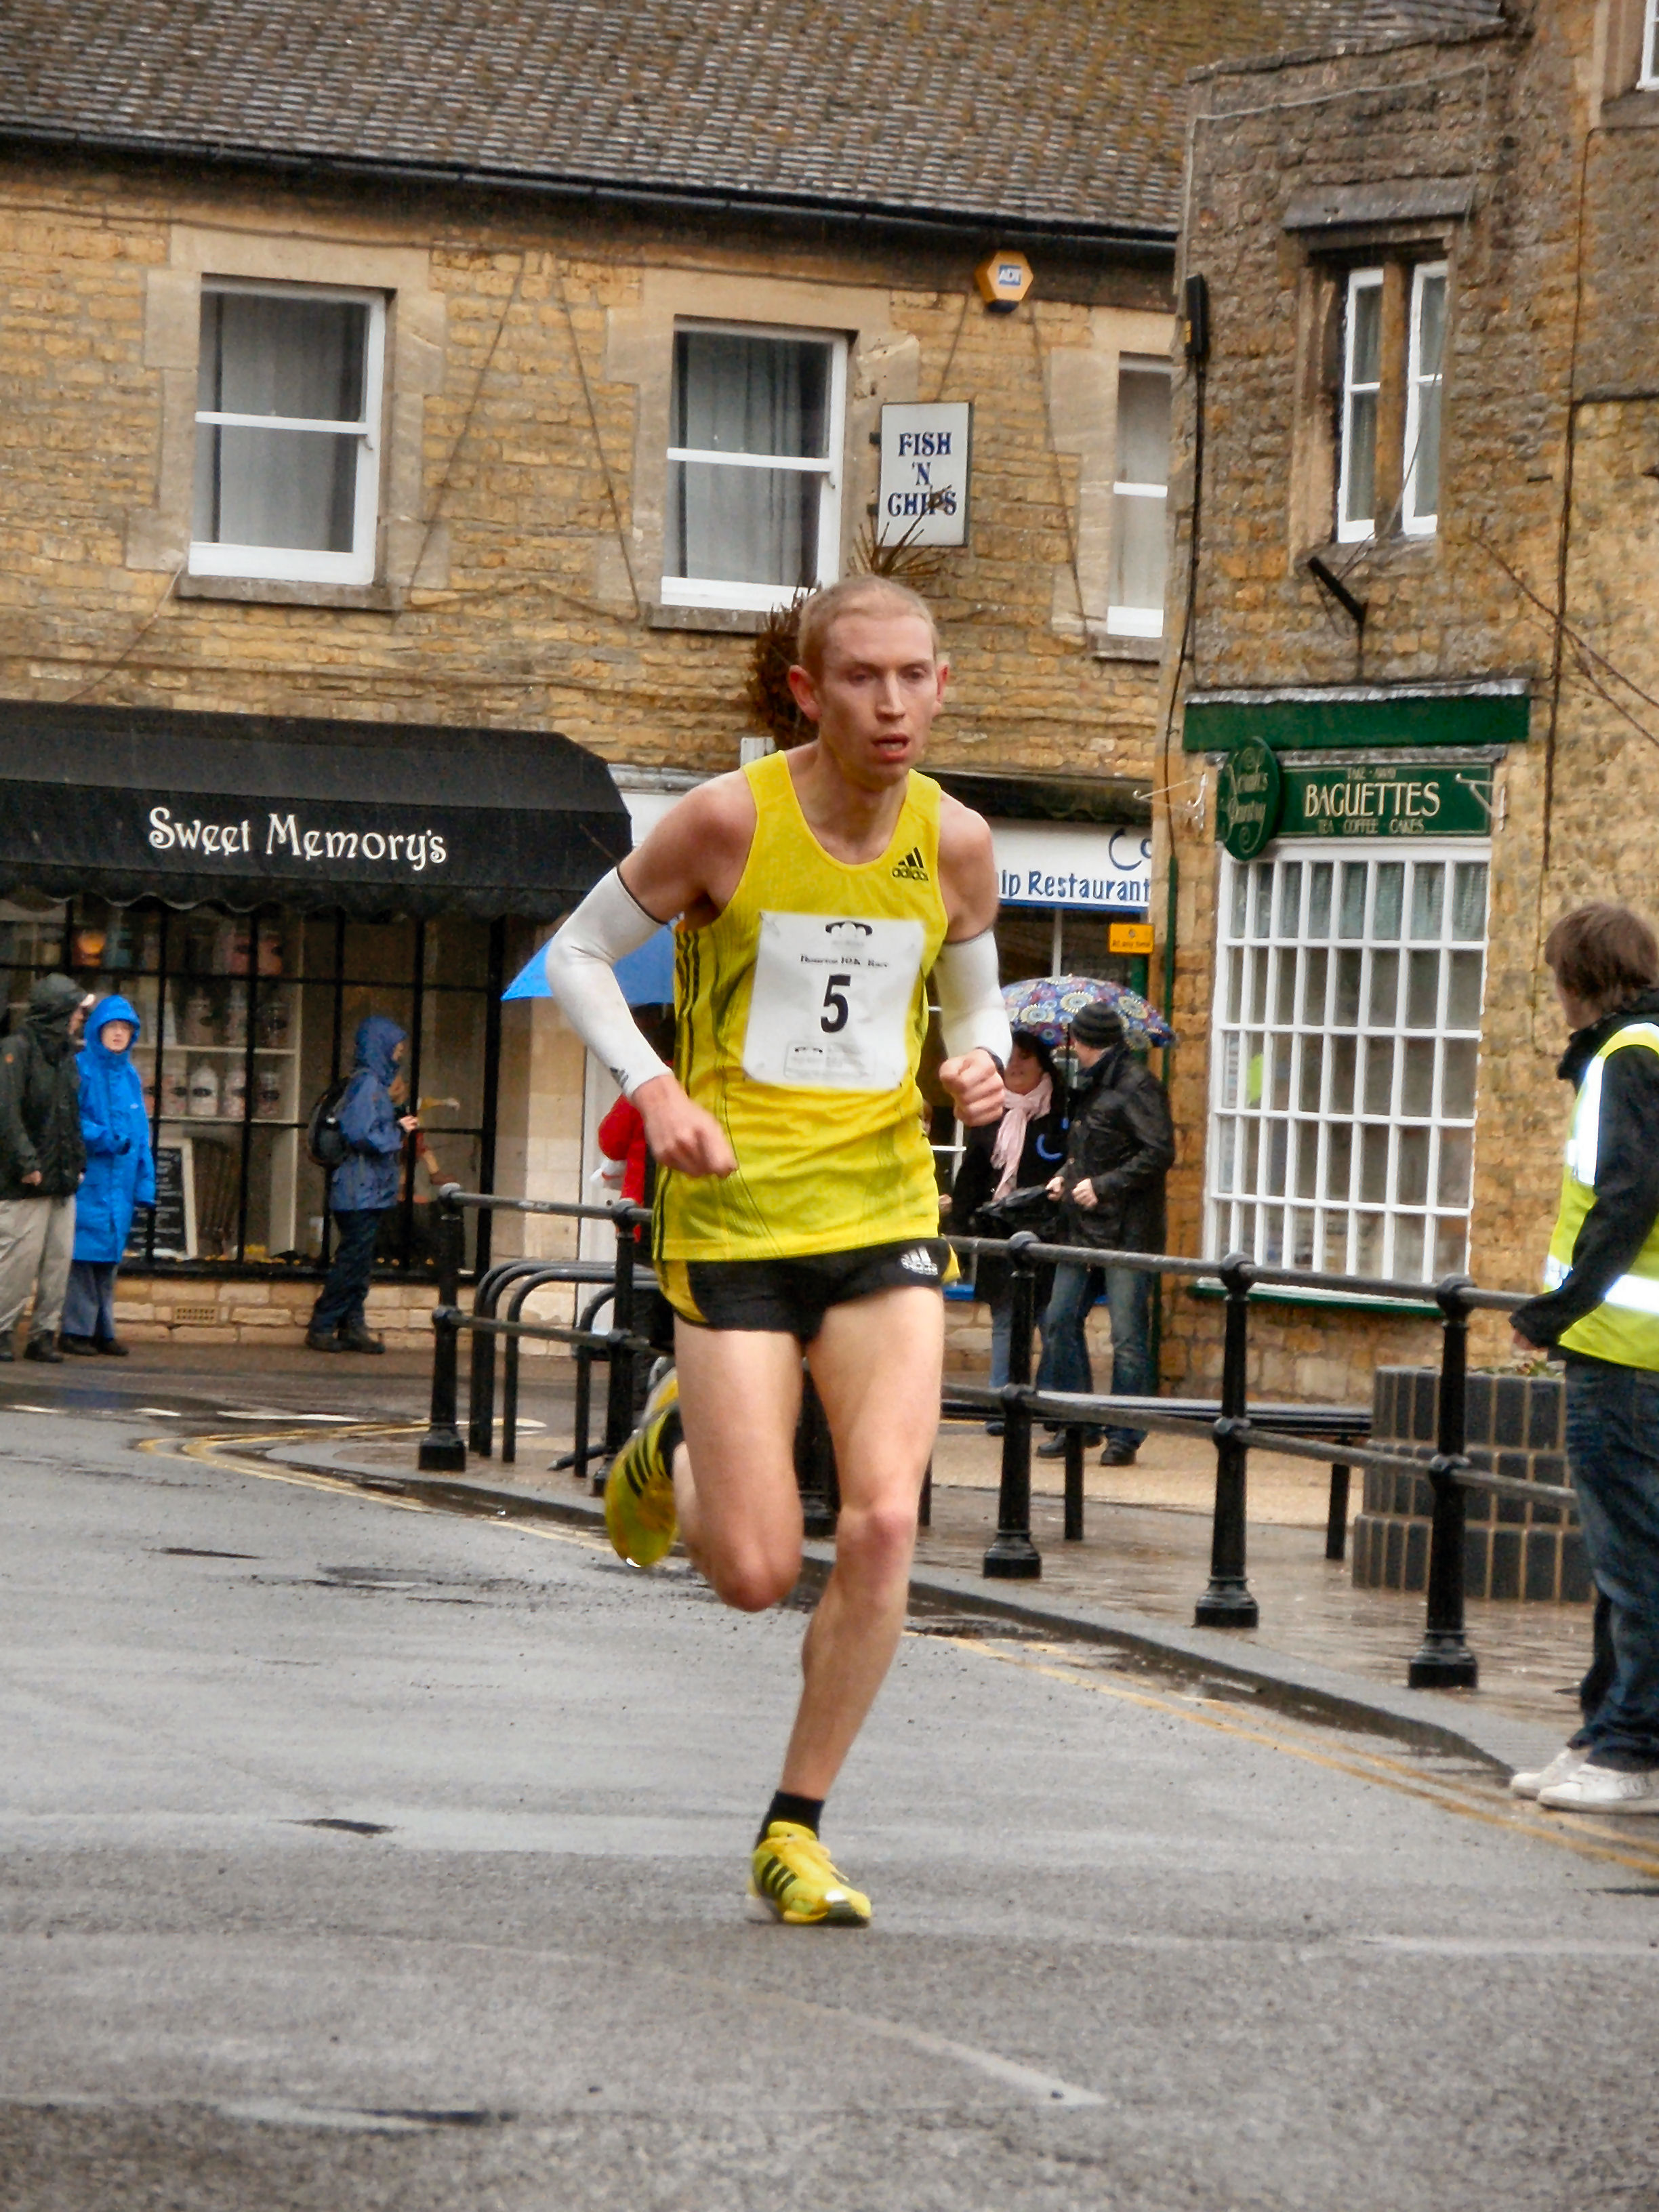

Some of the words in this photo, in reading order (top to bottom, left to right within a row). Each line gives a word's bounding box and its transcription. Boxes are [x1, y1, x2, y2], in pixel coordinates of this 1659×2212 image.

[899, 432, 952, 457] FISH
[887, 491, 957, 517] CHIPS
[1304, 781, 1441, 818] BAGUETTES
[149, 806, 249, 857] Sweet
[266, 813, 447, 871] Memory's
[1343, 818, 1378, 834] COFFEE
[1389, 818, 1425, 835] CAKES
[1028, 870, 1150, 903] Restaurant
[820, 973, 851, 1033] 5
